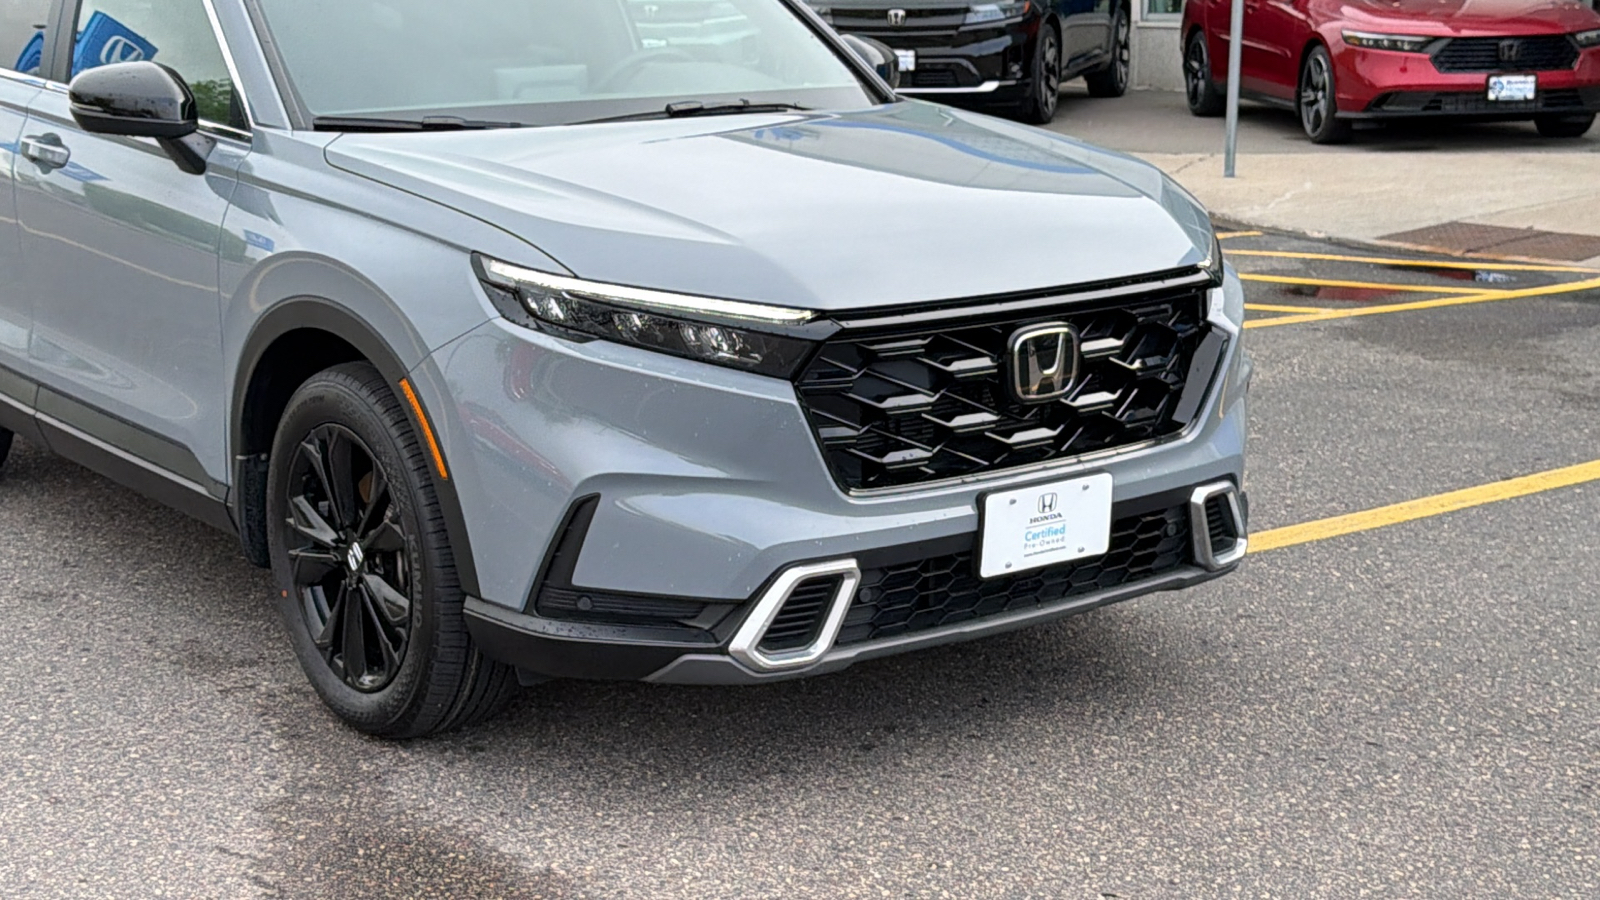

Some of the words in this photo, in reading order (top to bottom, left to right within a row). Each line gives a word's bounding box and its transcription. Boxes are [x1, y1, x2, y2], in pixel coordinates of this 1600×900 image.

[1029, 512, 1063, 524] HONDA
[1025, 524, 1066, 542] Certified
[1024, 536, 1065, 550] Pre-Owned
[408, 533, 423, 629] KUMHO
